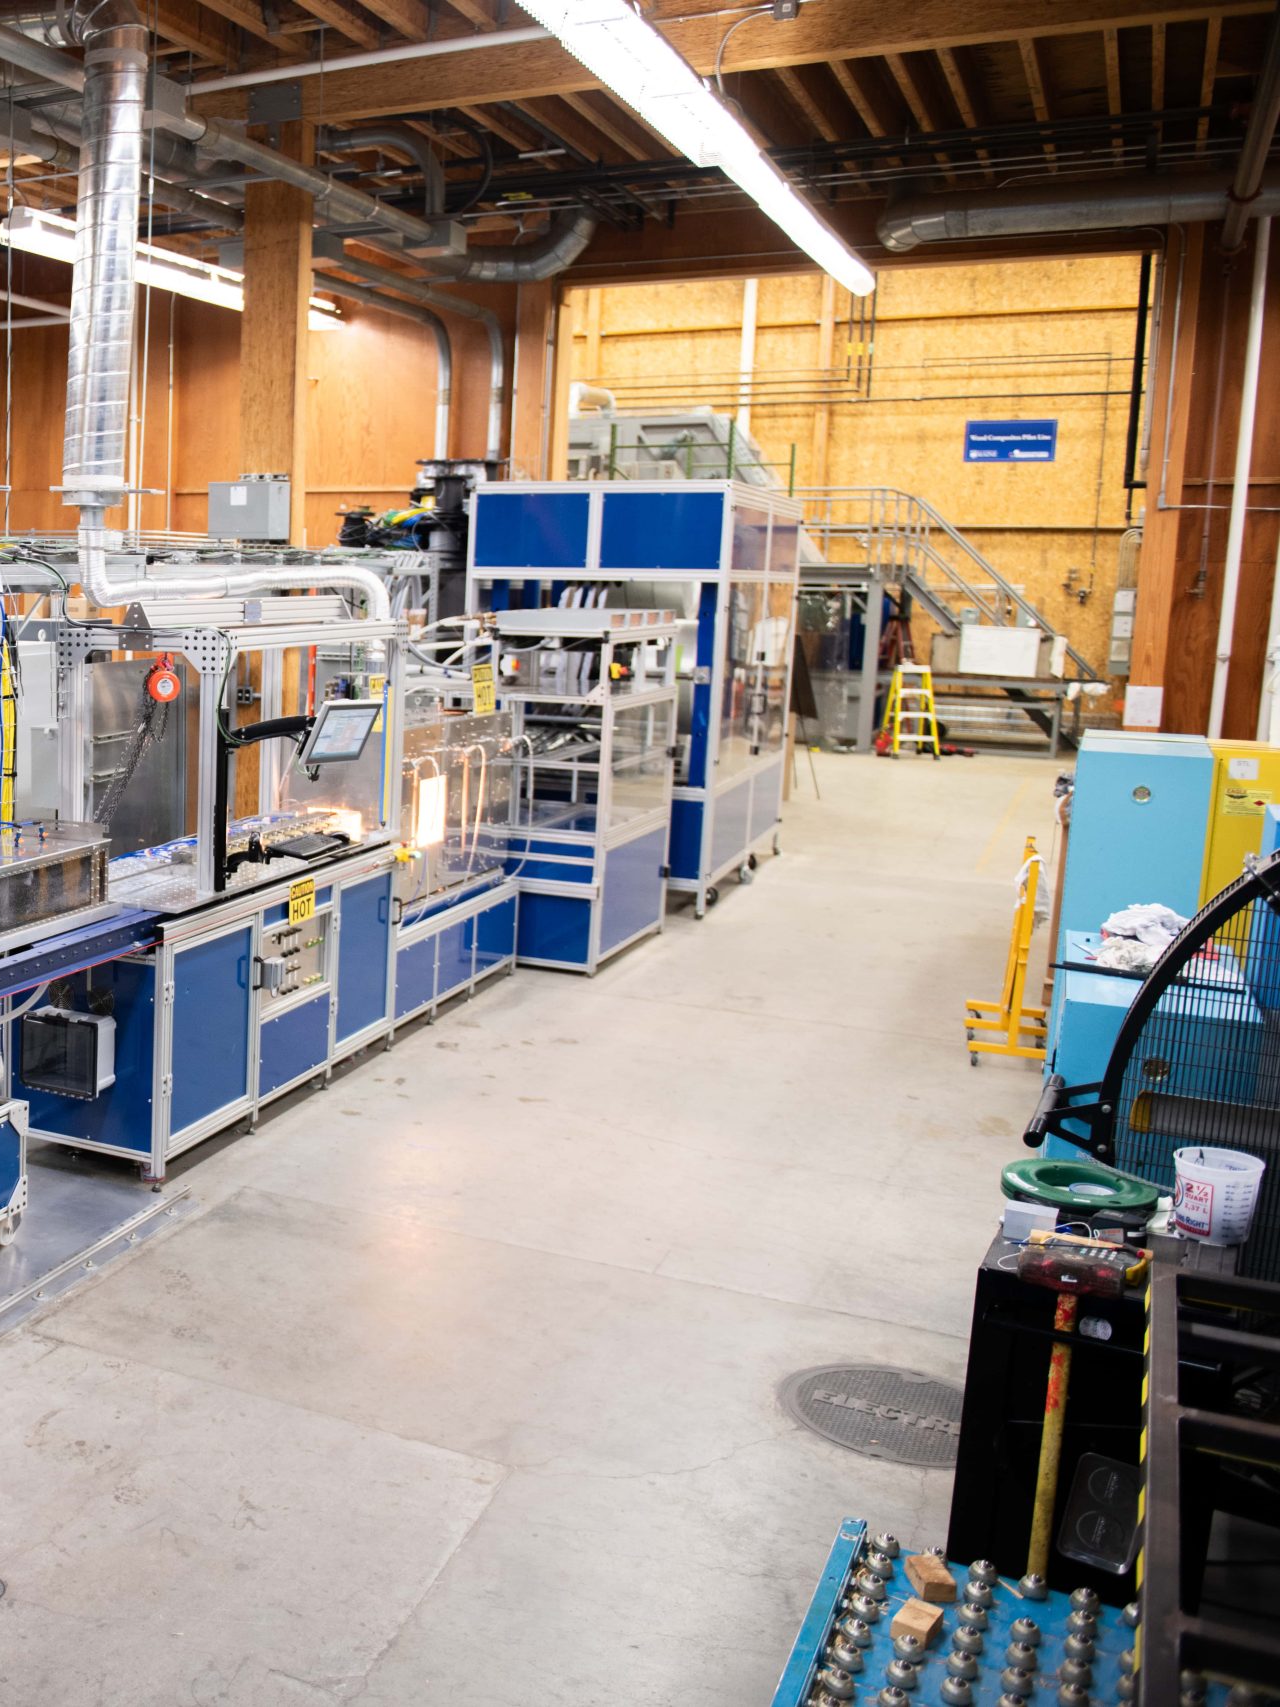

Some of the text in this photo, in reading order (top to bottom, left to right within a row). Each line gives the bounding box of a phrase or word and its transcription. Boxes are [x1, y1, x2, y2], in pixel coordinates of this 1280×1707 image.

[292, 898, 312, 921] HOT
[1185, 1182, 1194, 1193] 2
[1184, 1192, 1209, 1203] QUART
